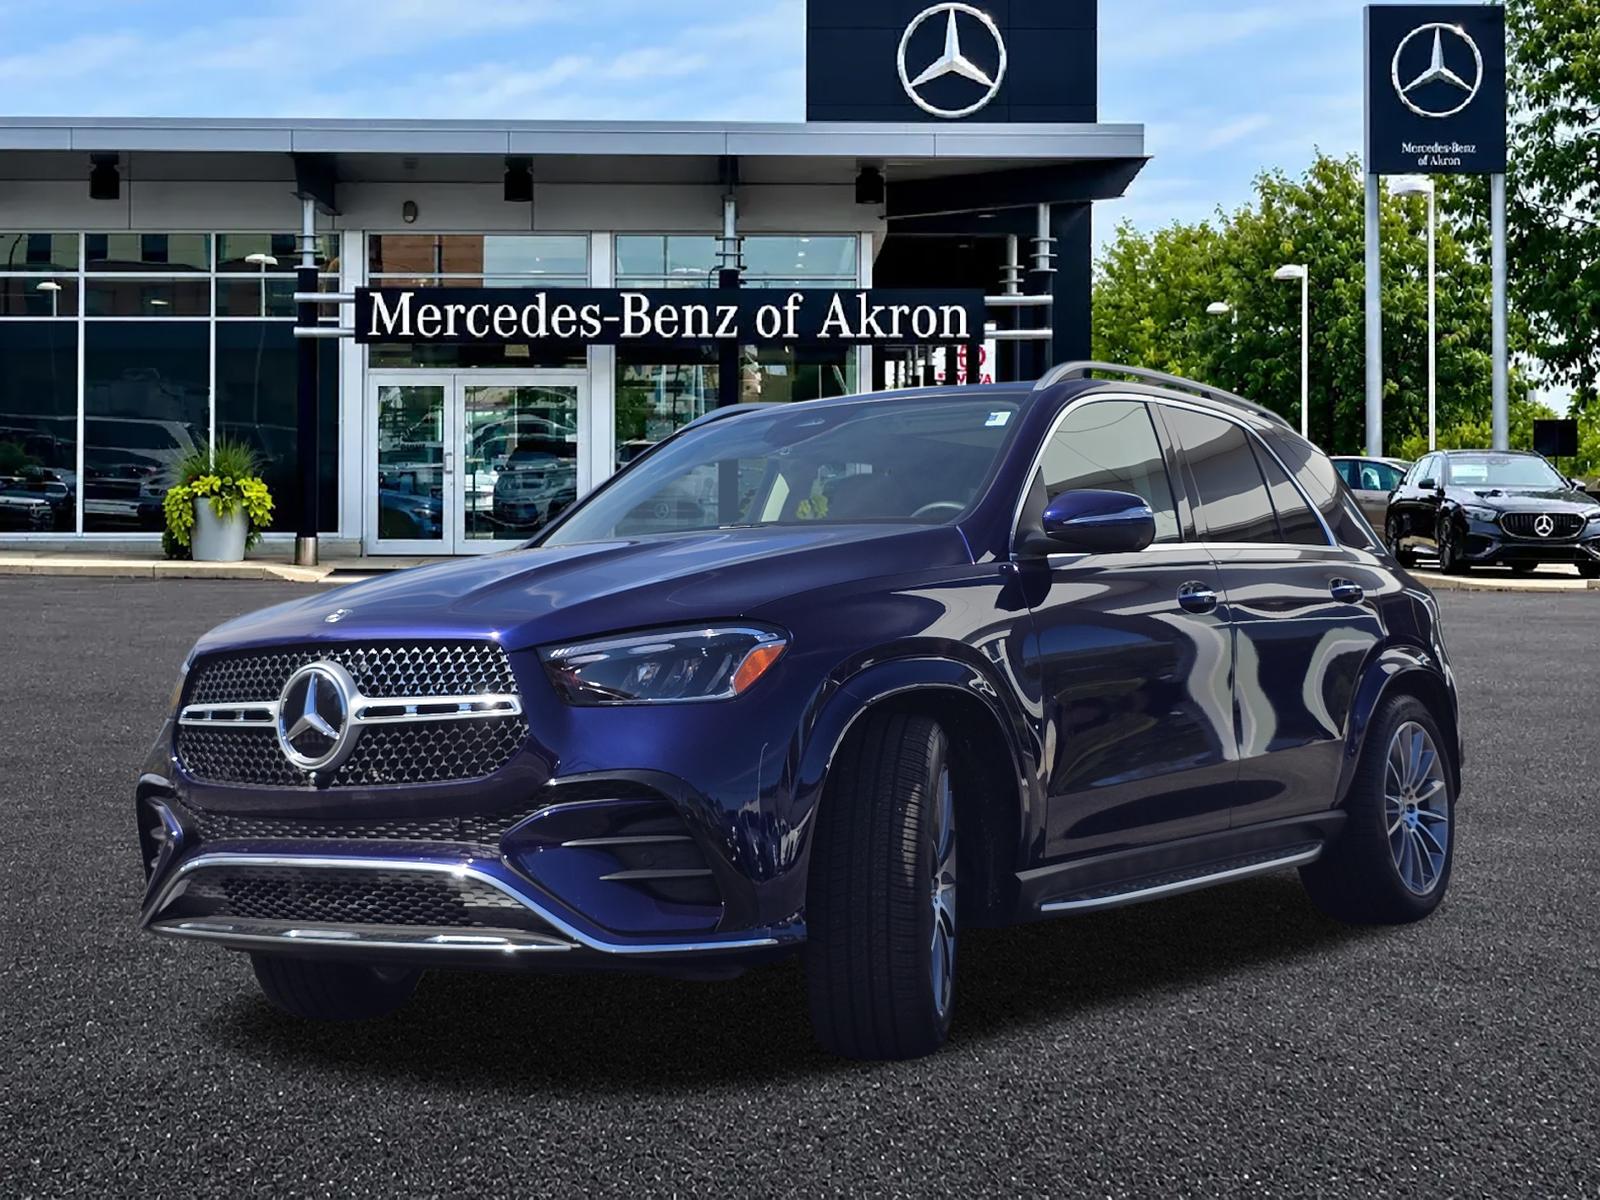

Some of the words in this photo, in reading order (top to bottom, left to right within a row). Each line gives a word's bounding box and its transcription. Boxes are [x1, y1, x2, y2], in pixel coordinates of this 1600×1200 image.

[1401, 142, 1476, 153] Mercedes-Benz
[1417, 154, 1428, 166] of
[1430, 154, 1461, 166] Akron
[367, 291, 739, 338] Mercedes-Benz
[755, 291, 804, 338] of
[816, 291, 971, 338] Akron
